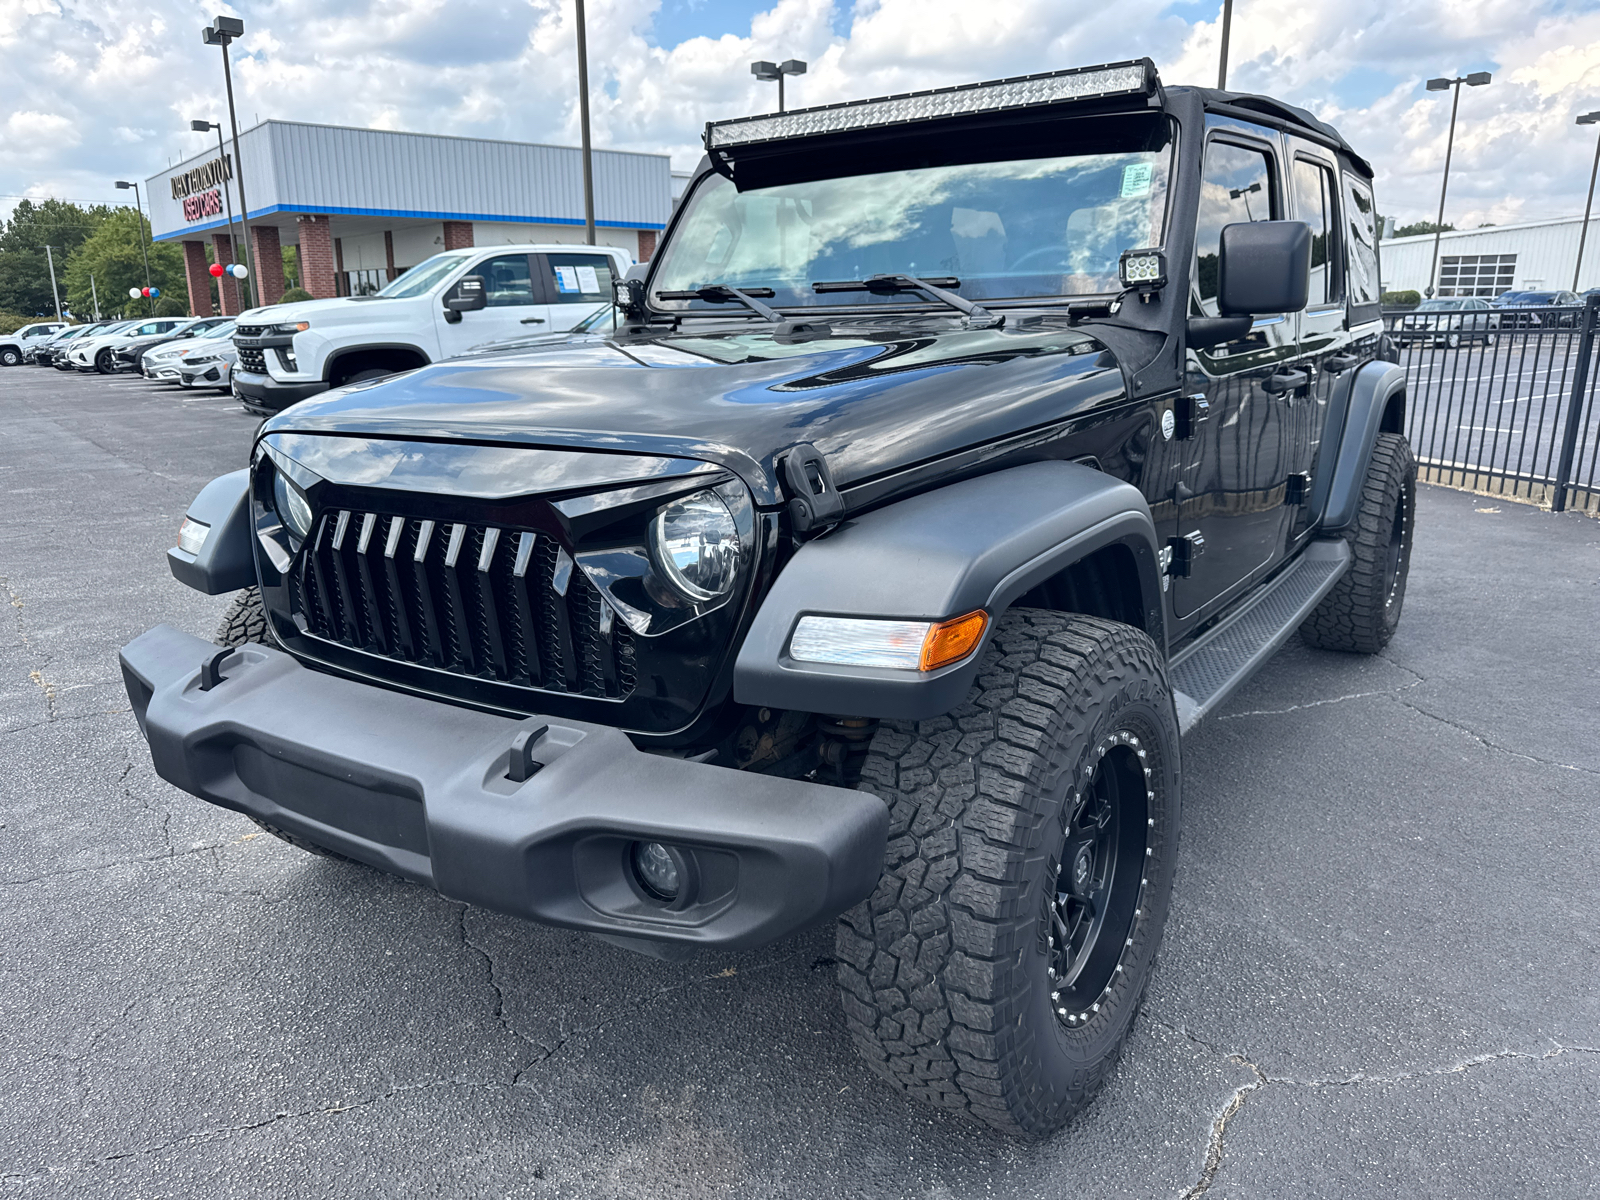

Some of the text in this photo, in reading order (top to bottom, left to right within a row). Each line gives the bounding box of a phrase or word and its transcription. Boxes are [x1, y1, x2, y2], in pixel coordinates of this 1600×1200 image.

[187, 153, 233, 194] THORNTON
[182, 189, 222, 221] USED CARS
